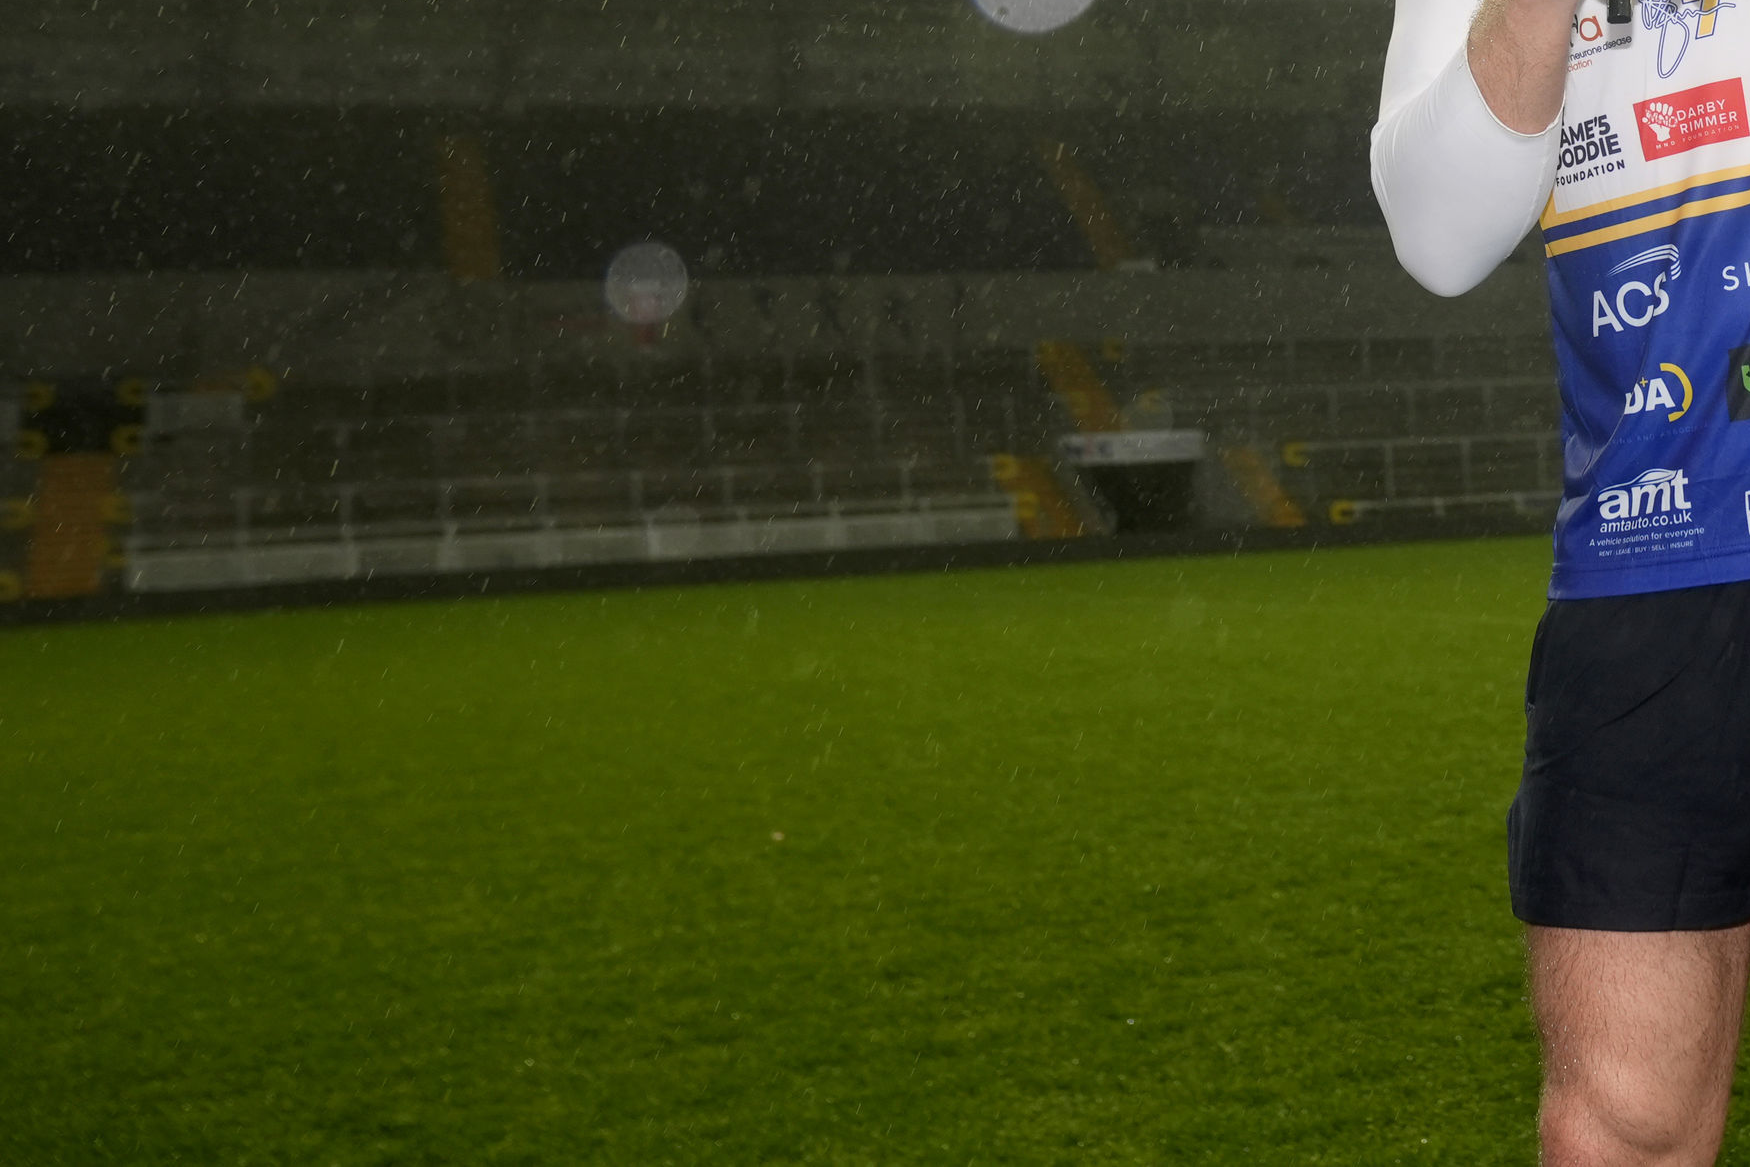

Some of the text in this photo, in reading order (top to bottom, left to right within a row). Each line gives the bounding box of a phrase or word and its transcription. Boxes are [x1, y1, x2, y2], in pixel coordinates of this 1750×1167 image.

[1676, 98, 1727, 121] DARBY
[1679, 111, 1738, 135] RIMMER
[1655, 124, 1741, 150] MND FOUNDATION
[1556, 159, 1626, 187] FOUNDATION
[1593, 271, 1670, 338] ACS
[1597, 468, 1692, 520] amt
[1599, 509, 1693, 533] amtauto.co.uk
[1589, 526, 1705, 547] A vehicle solution for everyone
[1634, 545, 1648, 553] BUY
[1651, 543, 1666, 552] SELL
[1669, 540, 1694, 549] INSURE
